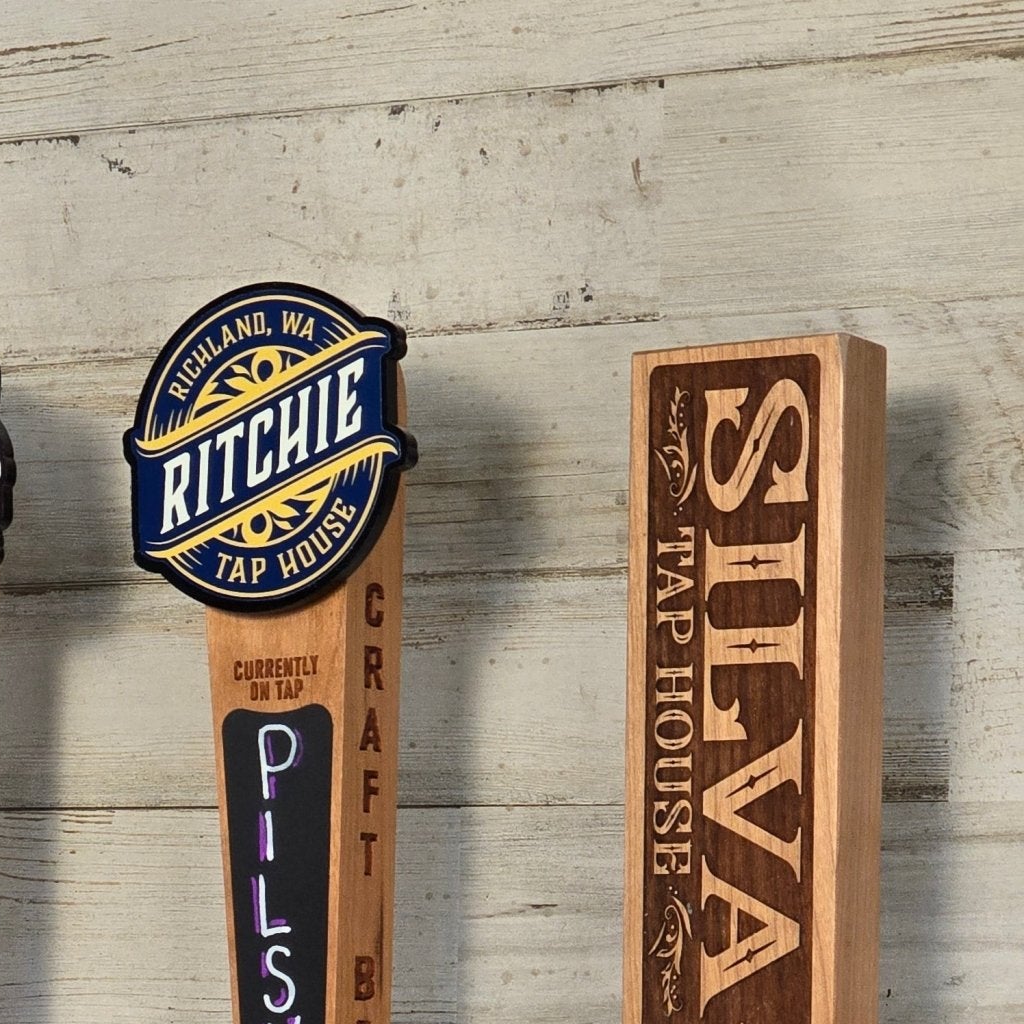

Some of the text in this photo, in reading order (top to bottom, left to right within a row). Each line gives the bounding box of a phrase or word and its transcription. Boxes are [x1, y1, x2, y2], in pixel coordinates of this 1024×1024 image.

[168, 310, 315, 402] RICHLAND, WA
[160, 357, 365, 535] RITCHIE
[215, 497, 357, 584] TAP HOUSE
[234, 655, 319, 681] CURRENTLY
[250, 678, 303, 701] ON TAP
[359, 582, 385, 876] CRAFT
[652, 525, 695, 875] TAP HOUSE
[699, 378, 810, 1018] SILVA
